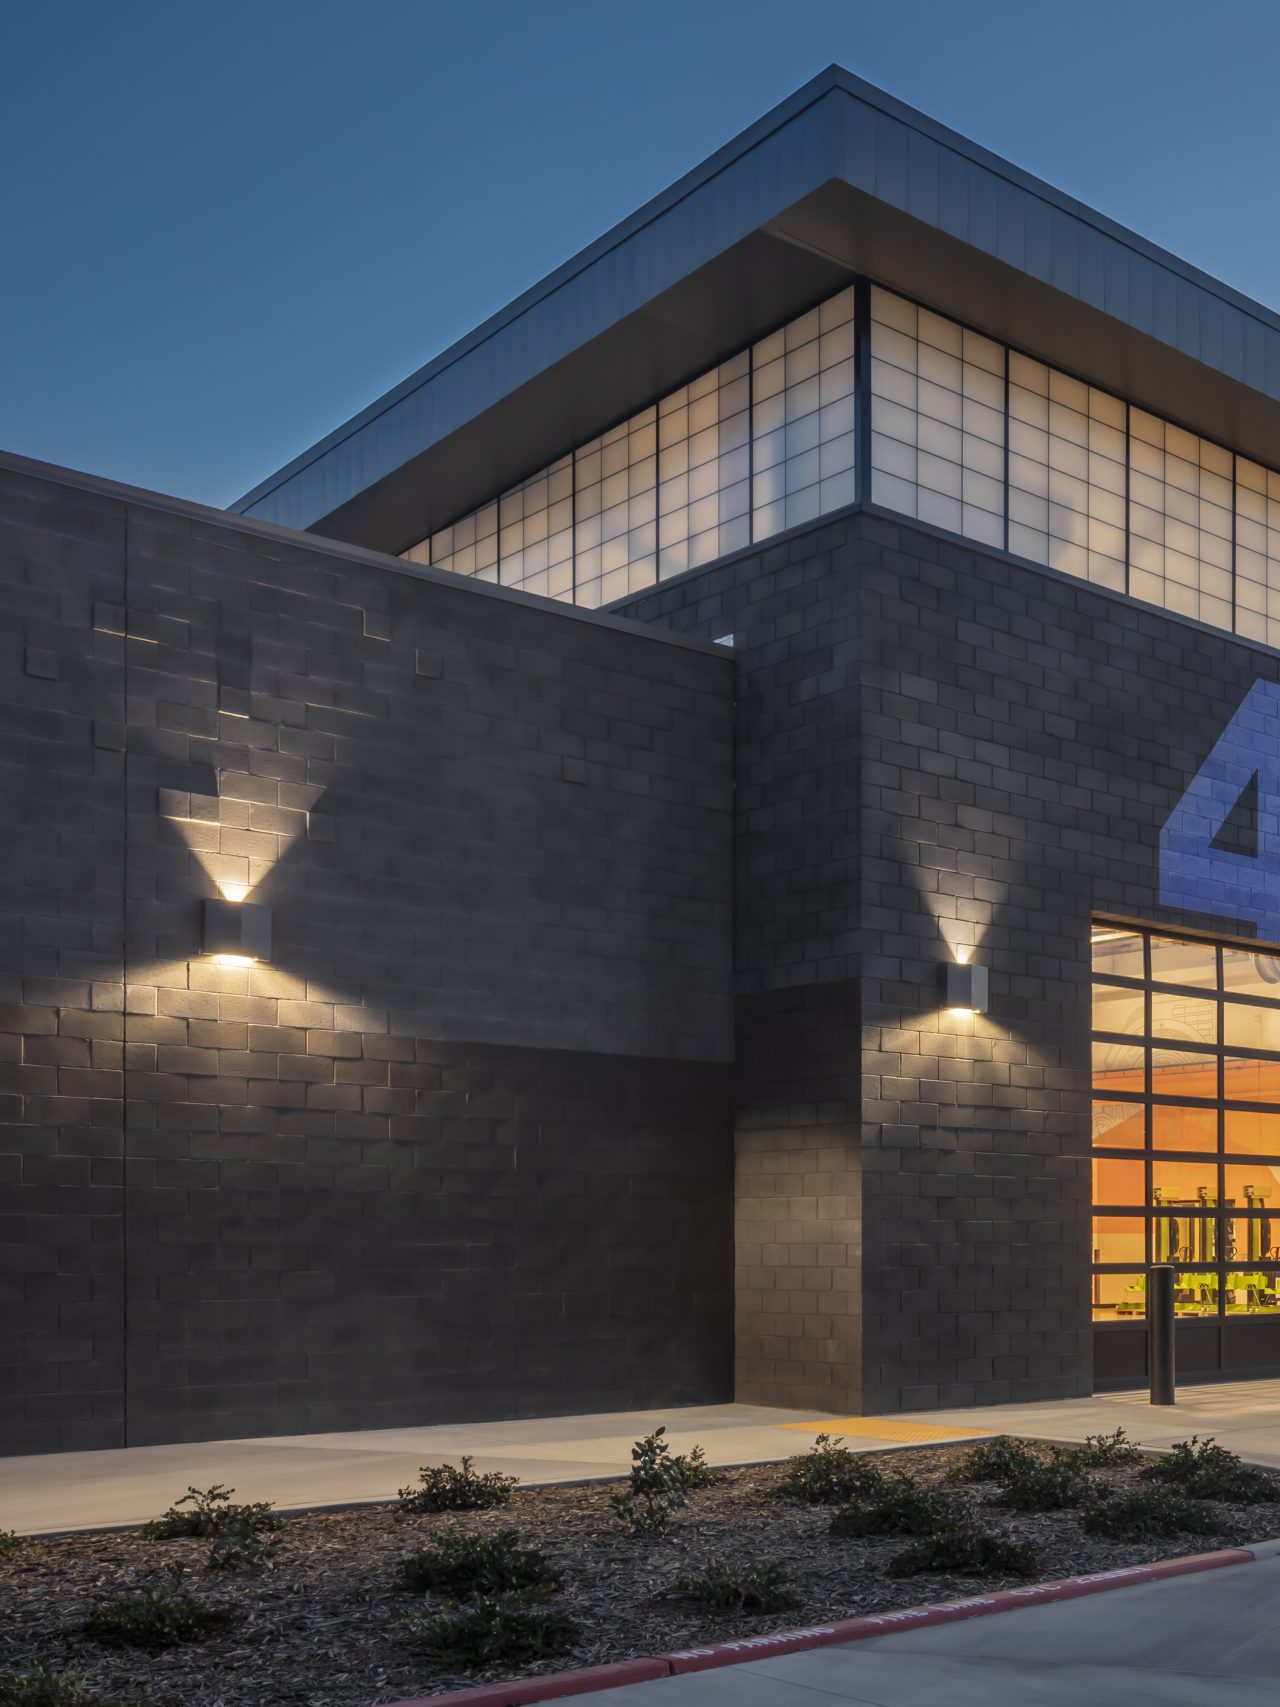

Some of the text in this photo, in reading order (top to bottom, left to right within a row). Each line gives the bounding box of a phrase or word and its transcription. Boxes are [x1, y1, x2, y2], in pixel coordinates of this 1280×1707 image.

[670, 1648, 715, 1660] NO
[721, 1627, 835, 1651] PARKING
[864, 1610, 928, 1625] FIRE
[928, 1597, 995, 1612] LANE
[1010, 1584, 1062, 1596] CVC
